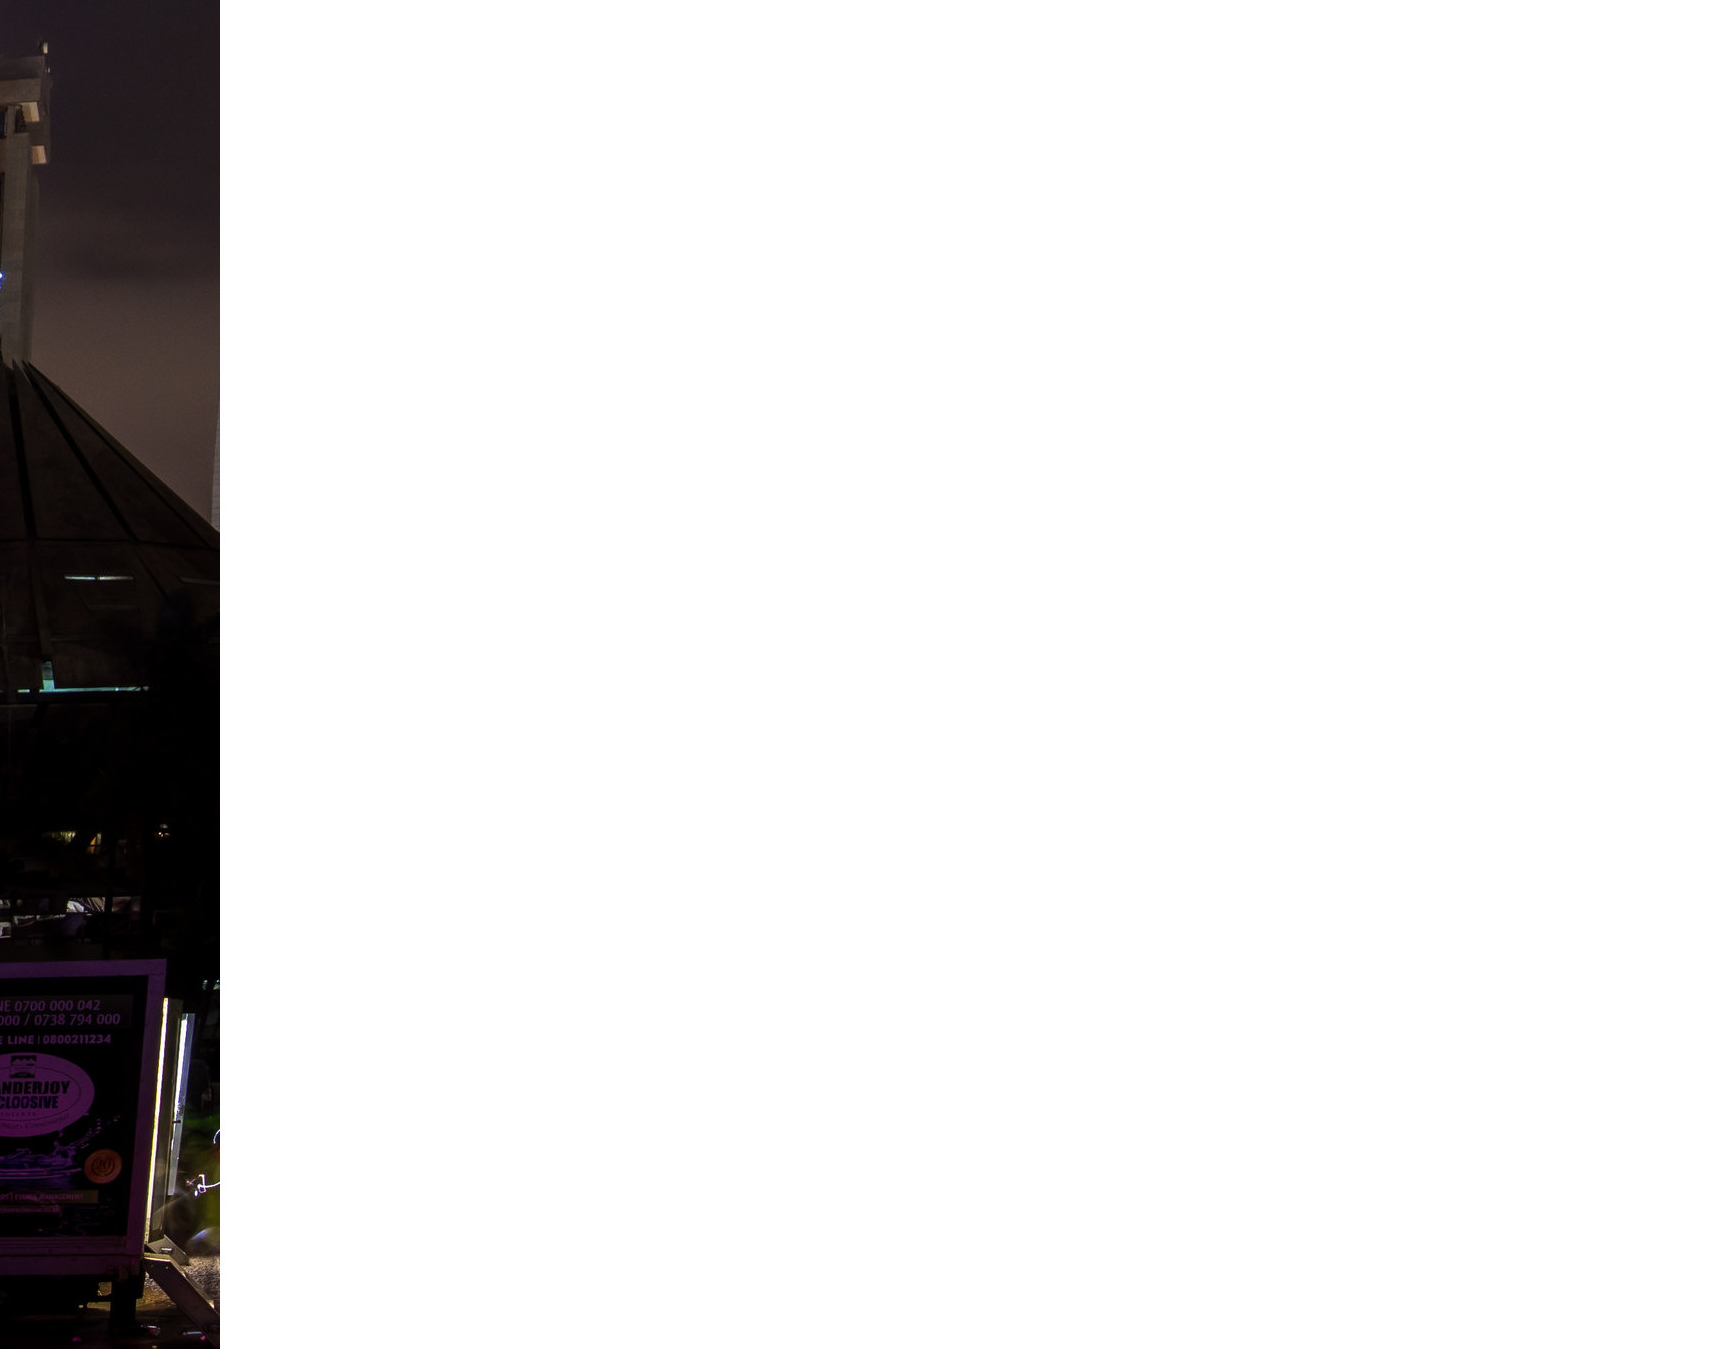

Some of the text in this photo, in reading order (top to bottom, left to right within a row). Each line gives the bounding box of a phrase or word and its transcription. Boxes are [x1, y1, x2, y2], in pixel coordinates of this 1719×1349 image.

[15, 1000, 46, 1012] 0700
[49, 1000, 74, 1012] 000
[77, 999, 102, 1011] 042
[34, 1013, 66, 1026] 0738
[69, 1013, 92, 1026] 794
[96, 1013, 121, 1025] 000
[7, 1035, 35, 1045] LINE
[43, 1034, 112, 1045] 0800211234
